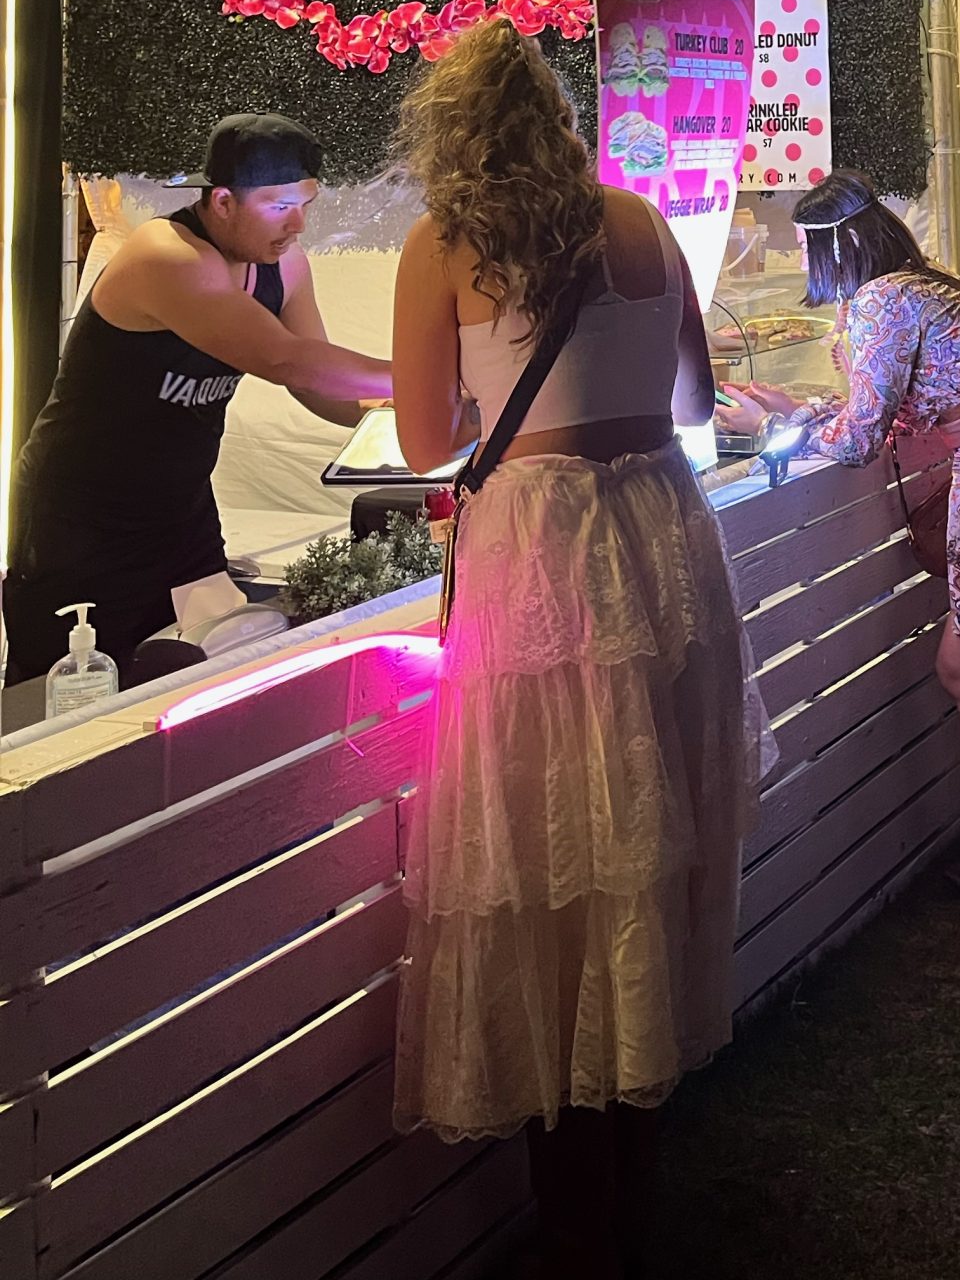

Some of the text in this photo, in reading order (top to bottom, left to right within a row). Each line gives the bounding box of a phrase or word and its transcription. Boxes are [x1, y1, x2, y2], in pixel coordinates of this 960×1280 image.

[675, 33, 744, 56] TURKEY CLUB 20
[778, 32, 818, 48] DONUT
[759, 53, 770, 63] $8
[673, 116, 731, 134] HANGOVER 20
[767, 117, 809, 132] COOKIE
[762, 138, 773, 148] $7
[665, 199, 692, 219] VEGGIE
[693, 196, 716, 215] WRAP
